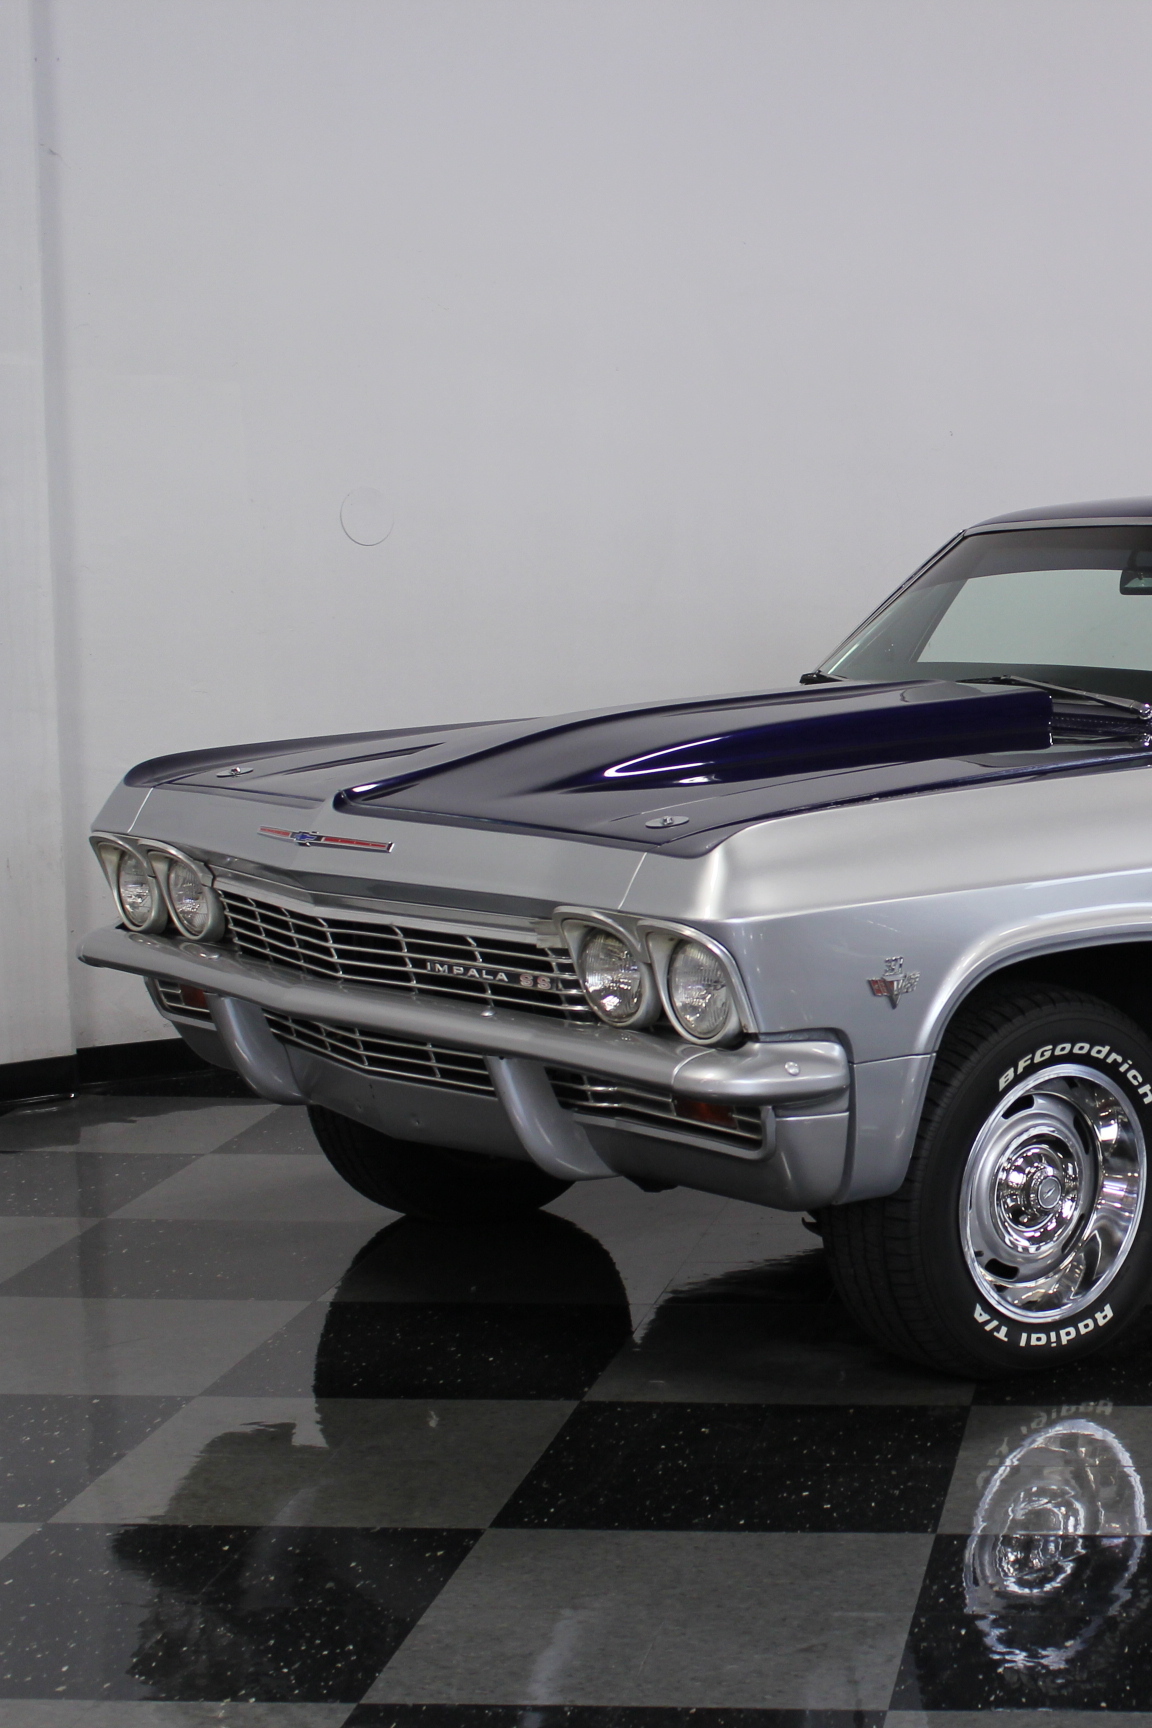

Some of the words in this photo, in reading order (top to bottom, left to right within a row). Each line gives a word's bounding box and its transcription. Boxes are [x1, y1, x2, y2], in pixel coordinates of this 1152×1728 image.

[426, 961, 509, 982] IMPALA
[519, 973, 551, 990] SS
[973, 1302, 1009, 1342] T/A
[1019, 1303, 1114, 1347] Radial
